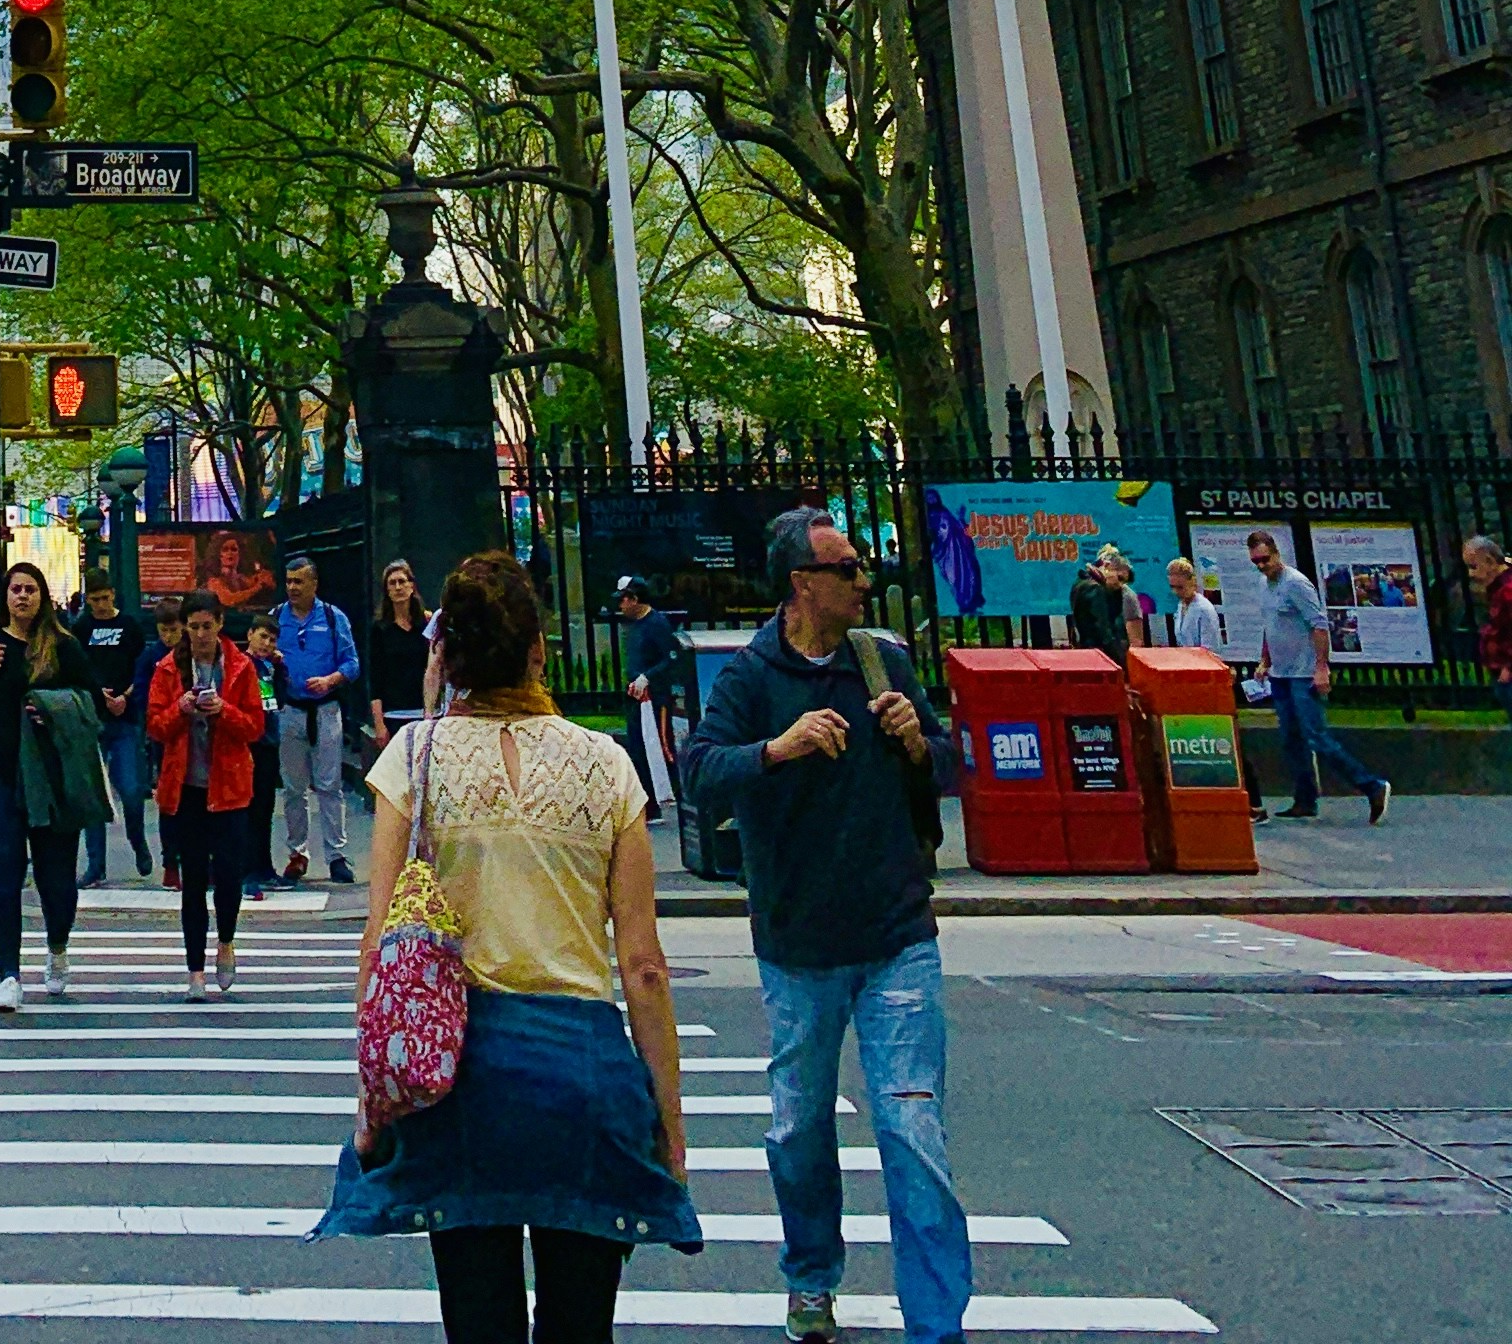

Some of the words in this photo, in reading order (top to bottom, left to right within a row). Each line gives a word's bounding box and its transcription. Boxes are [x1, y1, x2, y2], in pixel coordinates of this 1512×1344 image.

[103, 152, 144, 164] 209-211
[76, 163, 182, 192] Broadway
[89, 186, 123, 195] CANYON
[126, 186, 137, 195] OF
[141, 186, 172, 195] HEROES
[0, 251, 44, 273] WAY
[1227, 490, 1298, 509] PAUL'S
[1303, 491, 1391, 510] CHAPEL
[88, 628, 124, 646] NIKE
